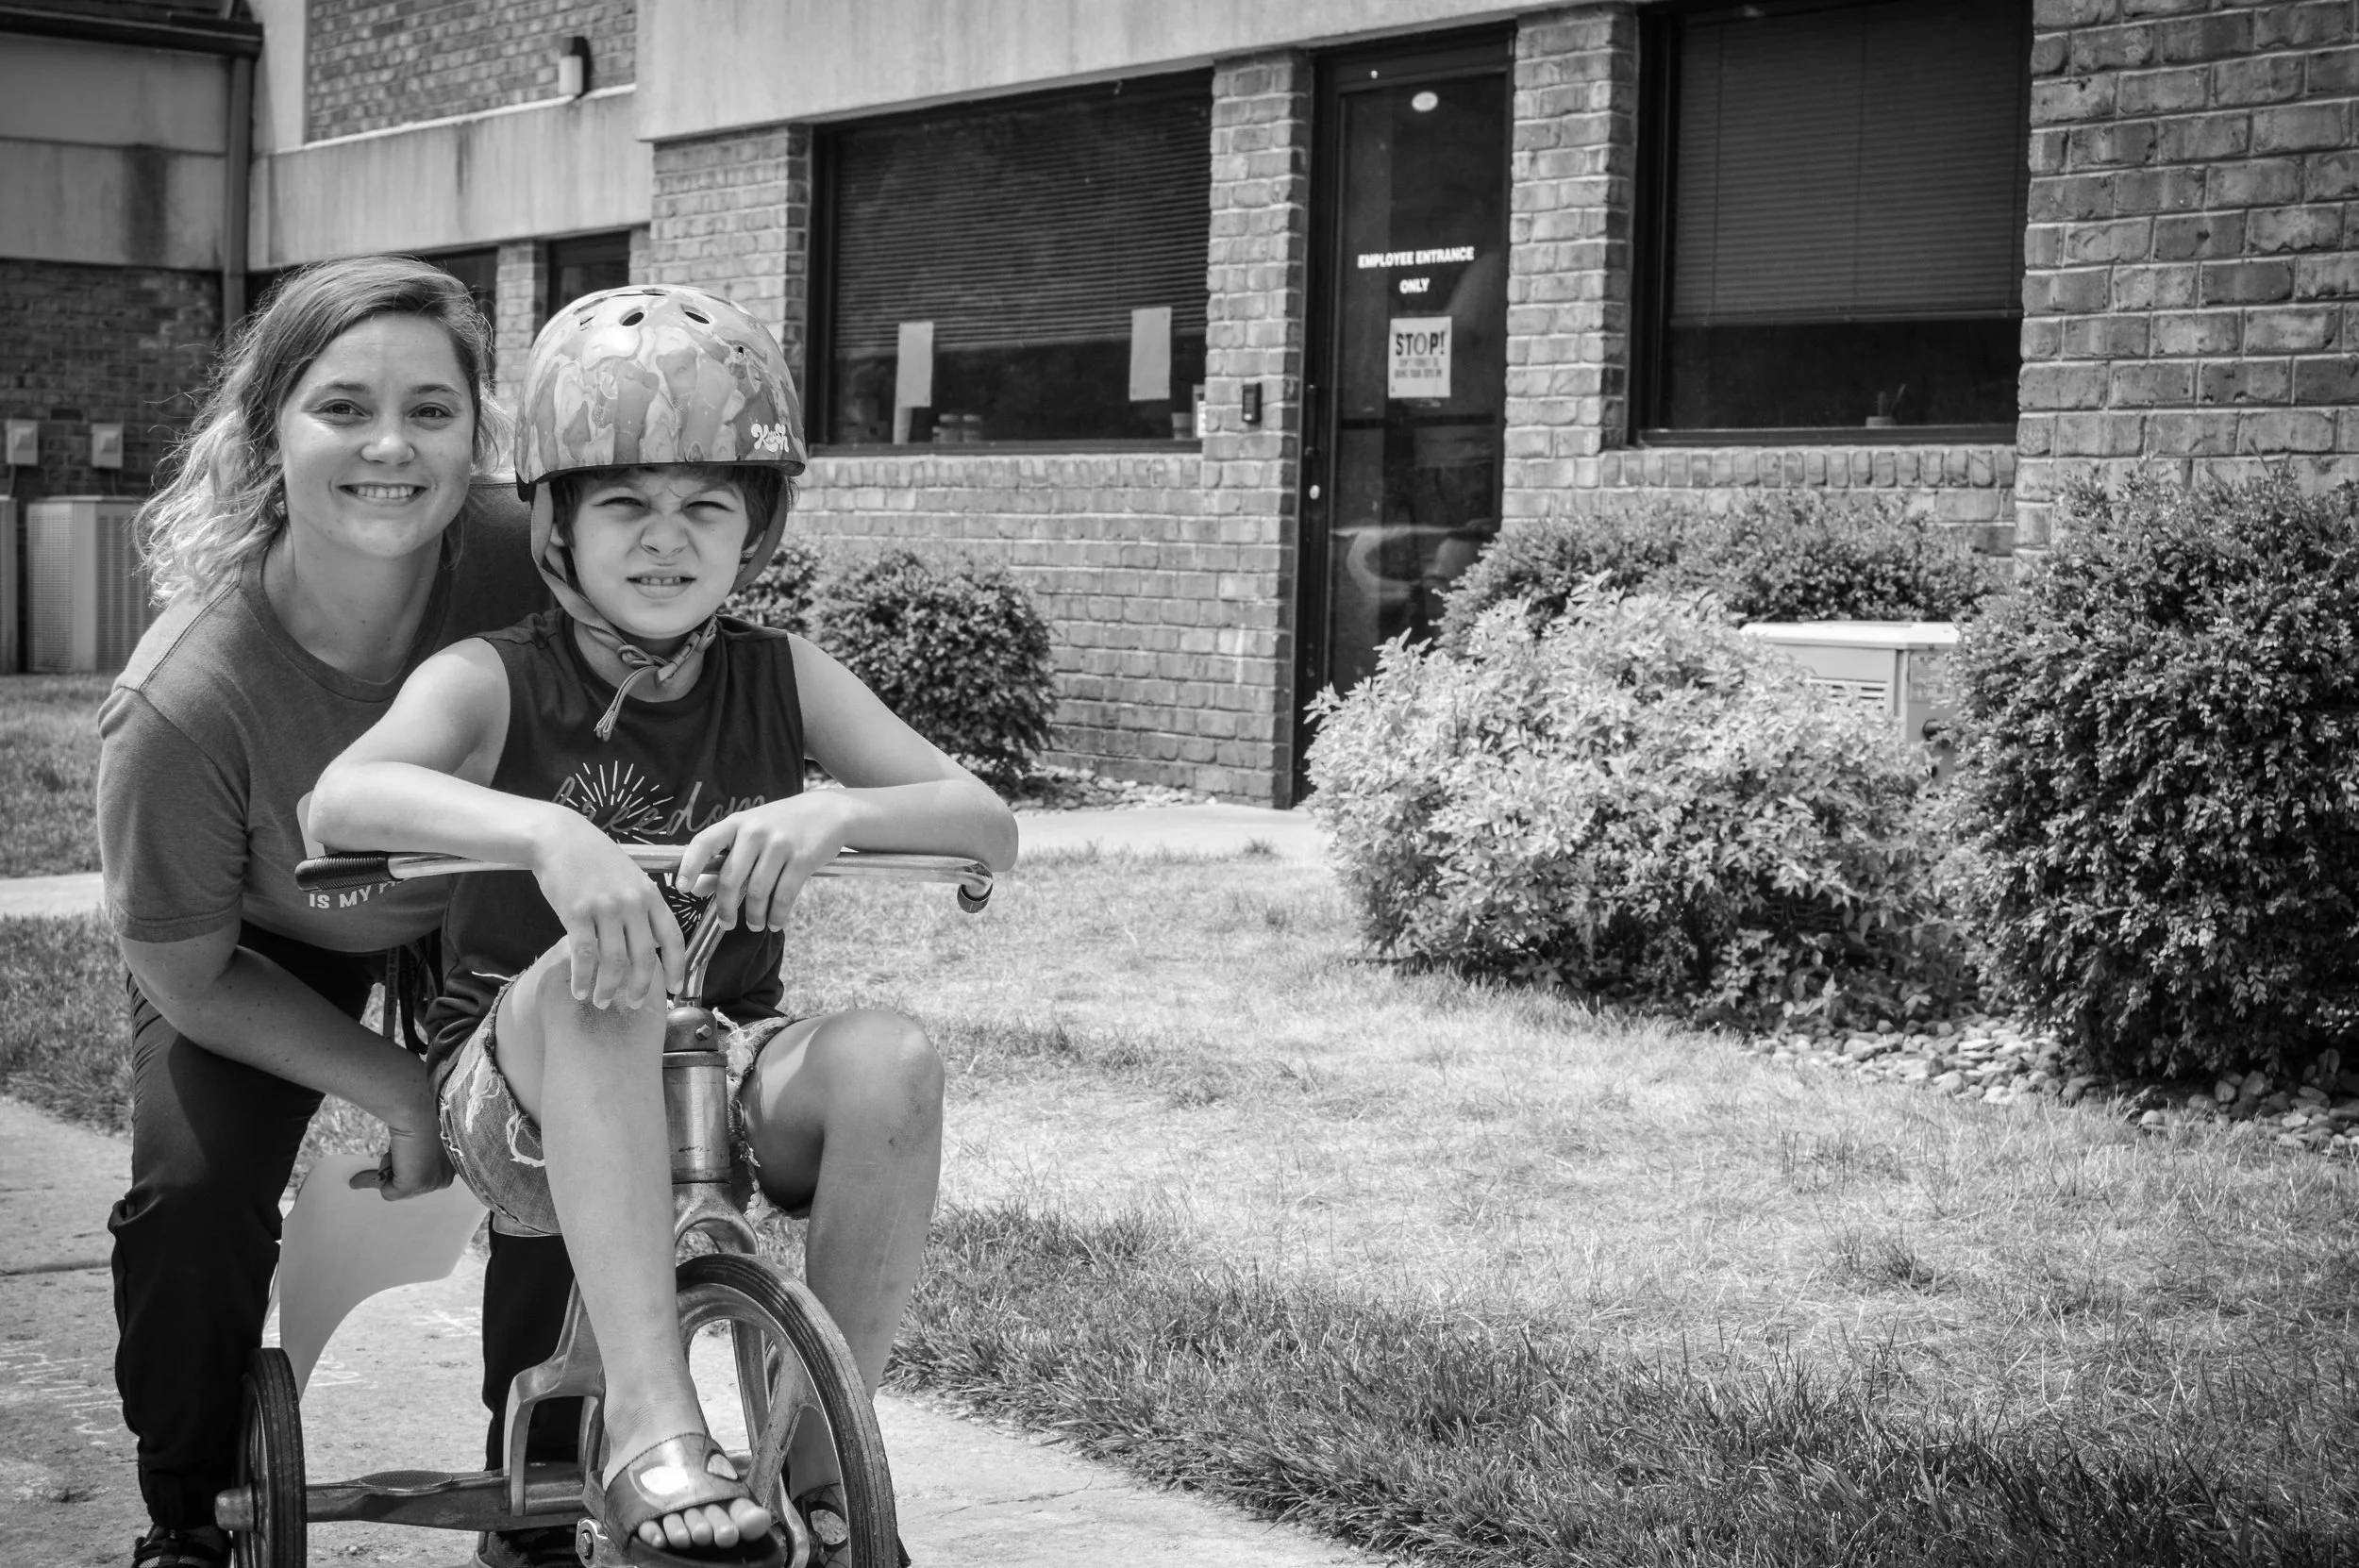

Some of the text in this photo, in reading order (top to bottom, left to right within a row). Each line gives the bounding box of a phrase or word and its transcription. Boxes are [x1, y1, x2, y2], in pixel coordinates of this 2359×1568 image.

[1358, 246, 1475, 268] EMPLOYEE ENTRANCE
[1399, 277, 1430, 294] ONLY
[1396, 331, 1445, 356] STOP!
[310, 893, 330, 909] IS
[340, 885, 372, 909] MY
